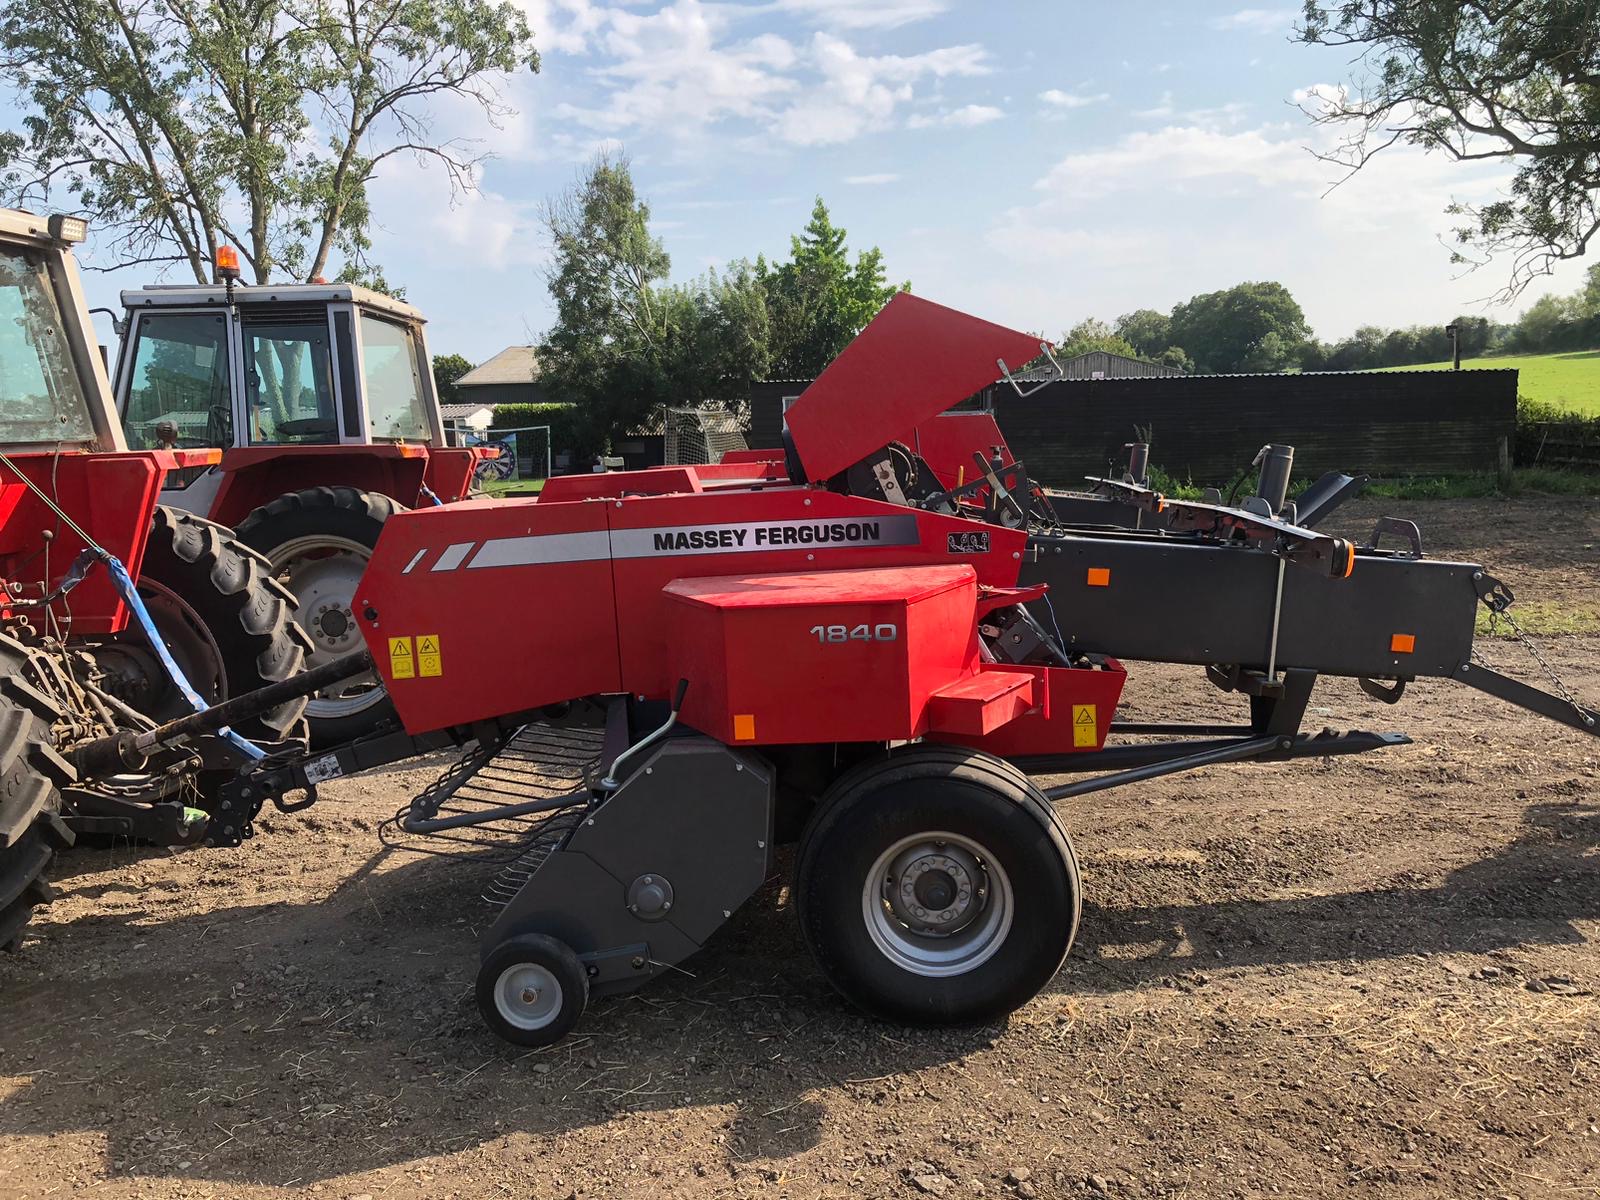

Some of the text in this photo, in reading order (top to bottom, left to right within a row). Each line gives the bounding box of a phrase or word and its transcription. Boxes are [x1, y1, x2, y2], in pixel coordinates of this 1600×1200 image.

[653, 522, 881, 551] MASSEY FERGUSON
[809, 623, 898, 644] 1840
